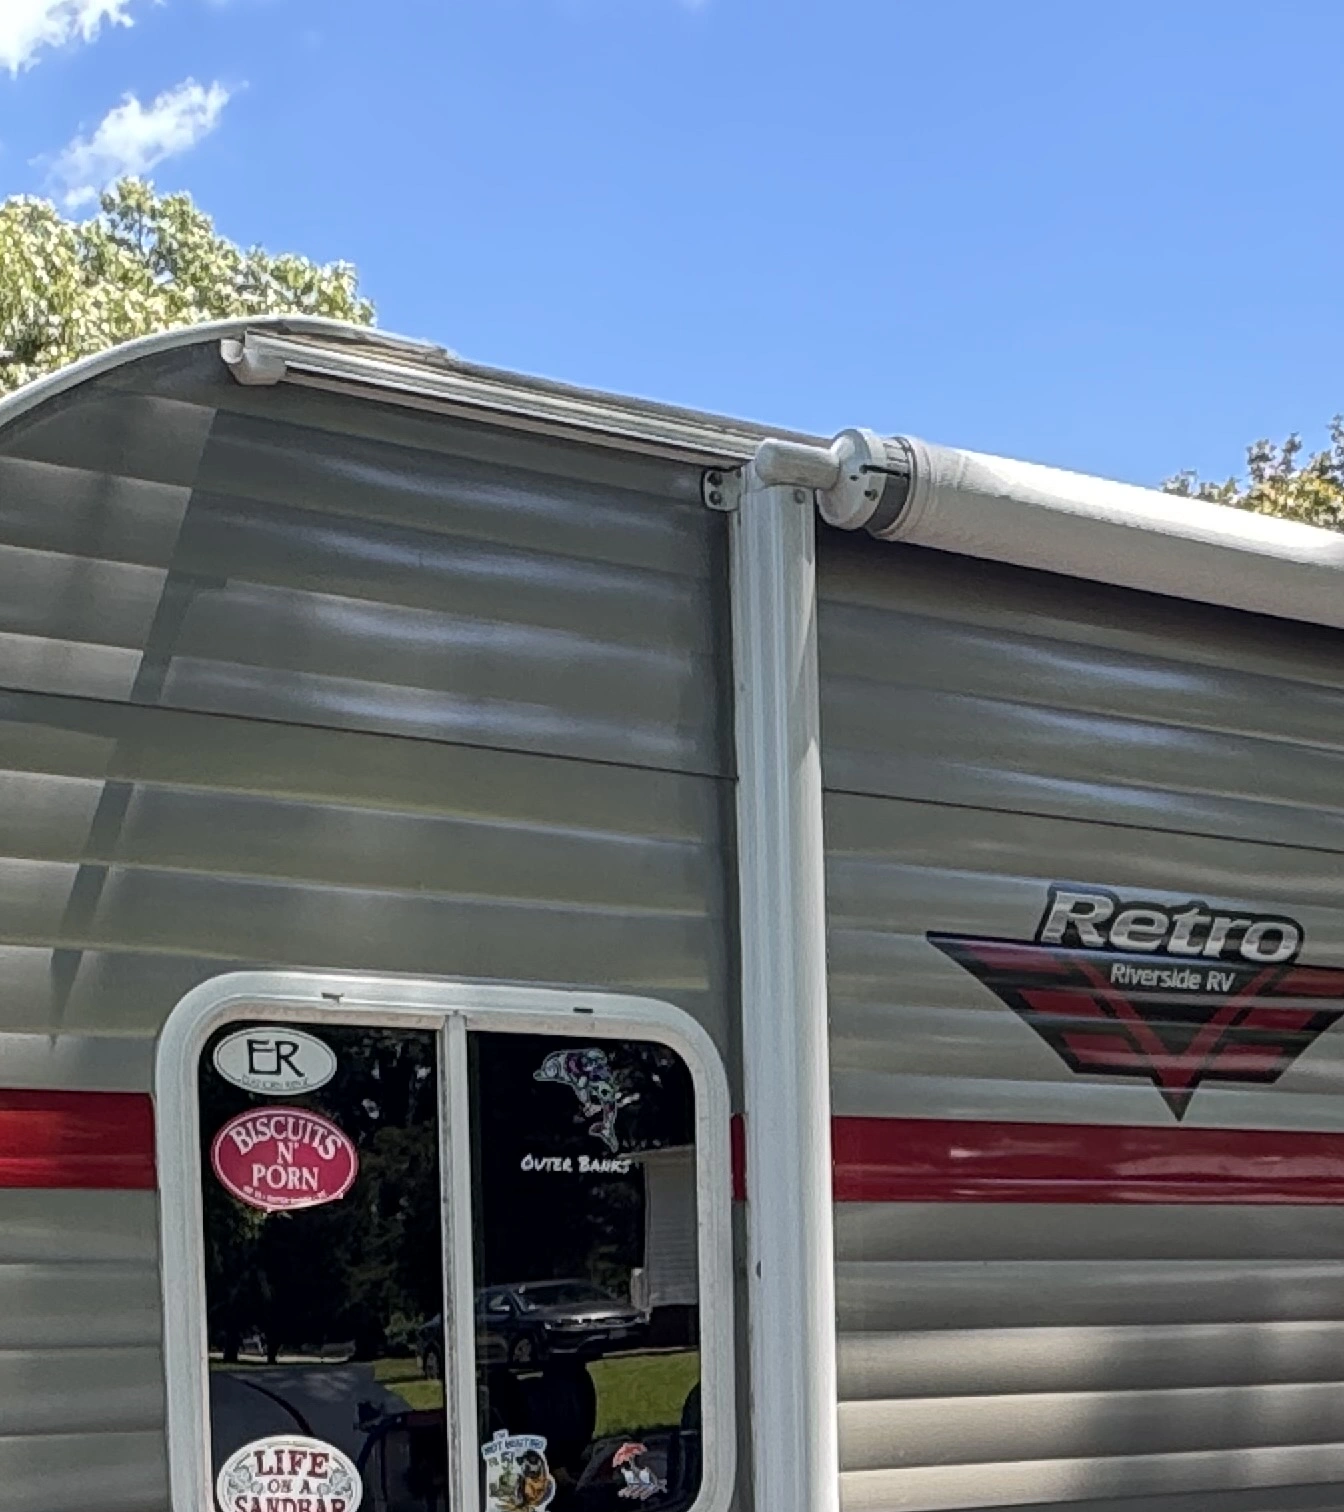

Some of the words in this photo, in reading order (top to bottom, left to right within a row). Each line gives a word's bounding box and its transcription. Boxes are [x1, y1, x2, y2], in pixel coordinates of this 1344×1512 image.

[1039, 888, 1302, 963] Retro
[1110, 962, 1202, 990] Riverside
[1205, 969, 1236, 993] RV
[246, 1038, 306, 1078] ER
[228, 1116, 343, 1160] BISCUITS
[252, 1163, 320, 1192] PORN
[253, 1449, 330, 1479] LIFE
[267, 1479, 293, 1494] ON
[298, 1479, 313, 1494] A
